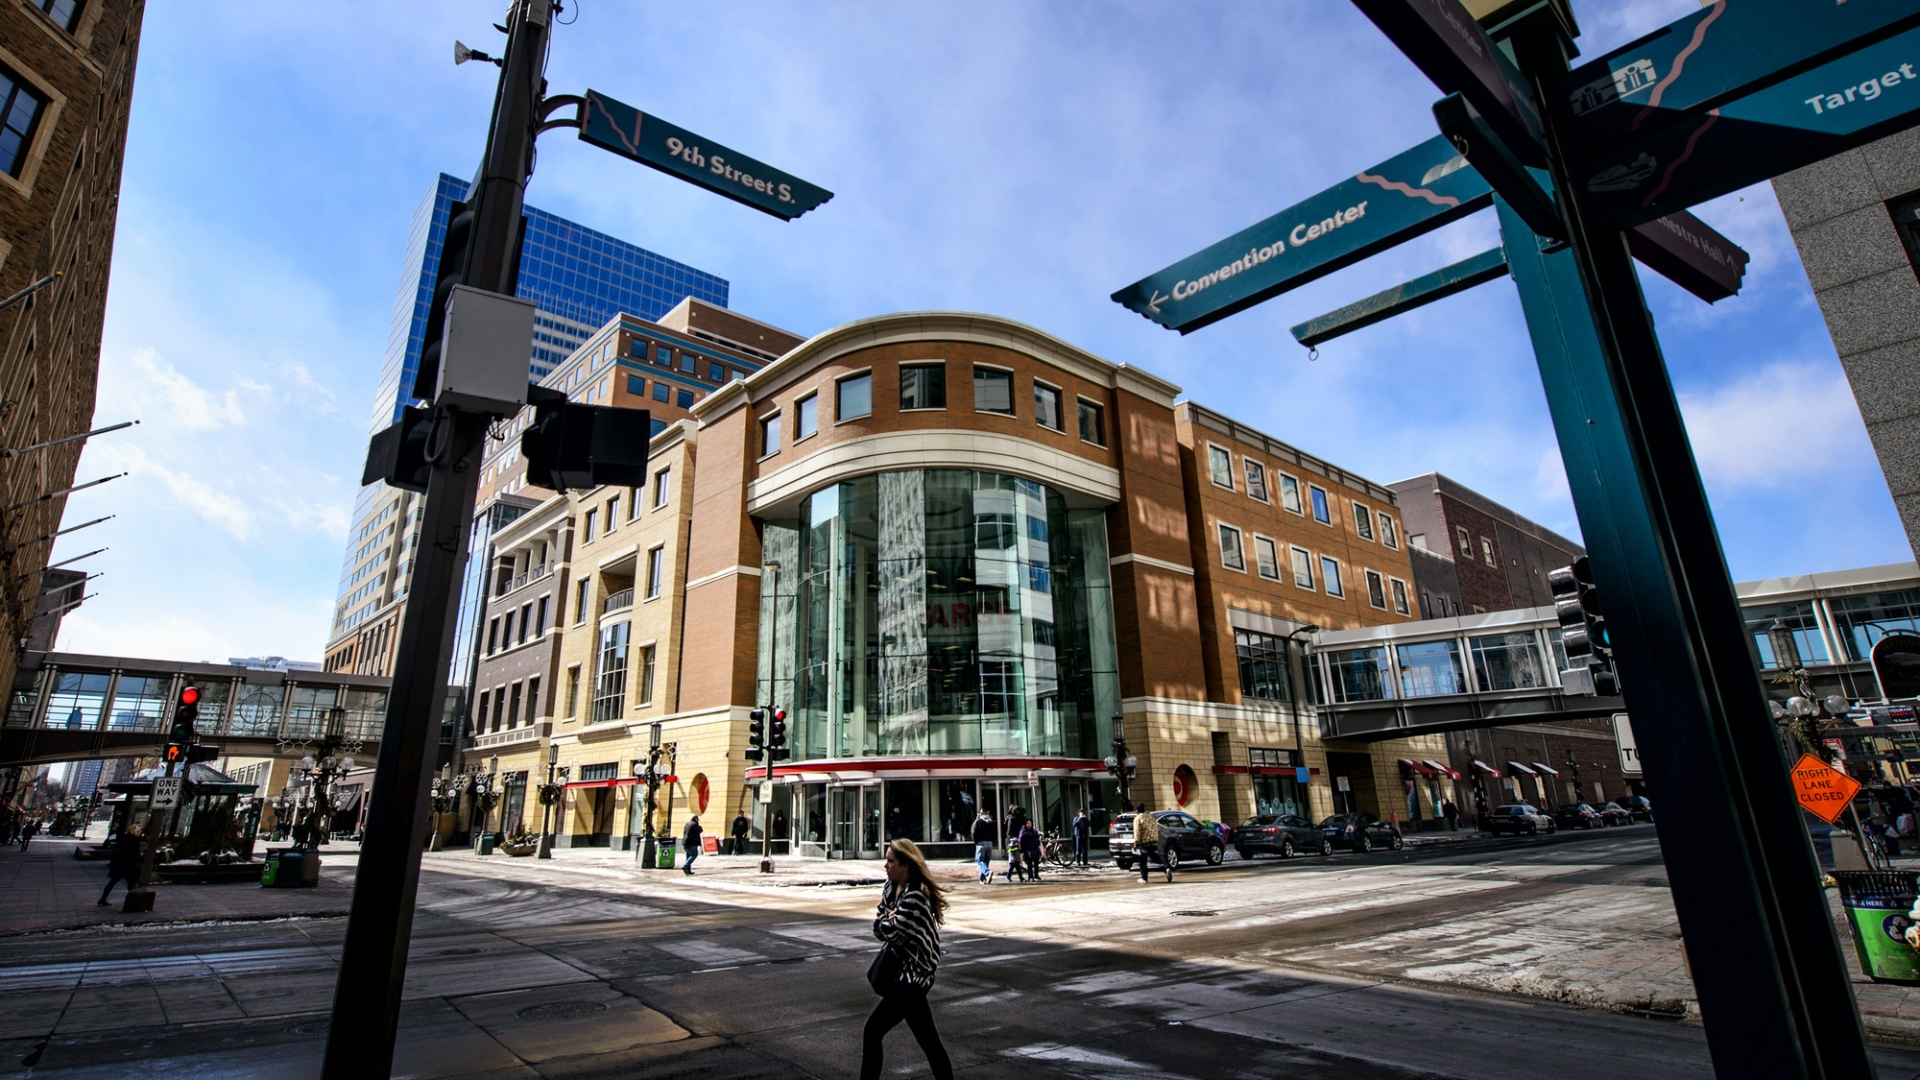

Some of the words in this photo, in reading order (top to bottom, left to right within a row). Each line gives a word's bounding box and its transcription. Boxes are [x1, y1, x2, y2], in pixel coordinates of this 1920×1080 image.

[1804, 63, 1917, 115] Target
[665, 137, 705, 168] 9th
[709, 155, 774, 196] Street
[777, 183, 796, 205] S.
[1171, 239, 1286, 301] Convention
[1289, 200, 1368, 247] Center
[1699, 237, 1727, 266] Hall
[1797, 768, 1829, 779] RIGHT
[158, 779, 179, 787] ONE
[1803, 780, 1833, 790] LANE
[156, 788, 178, 796] WAY
[1800, 791, 1844, 802] CLOSED
